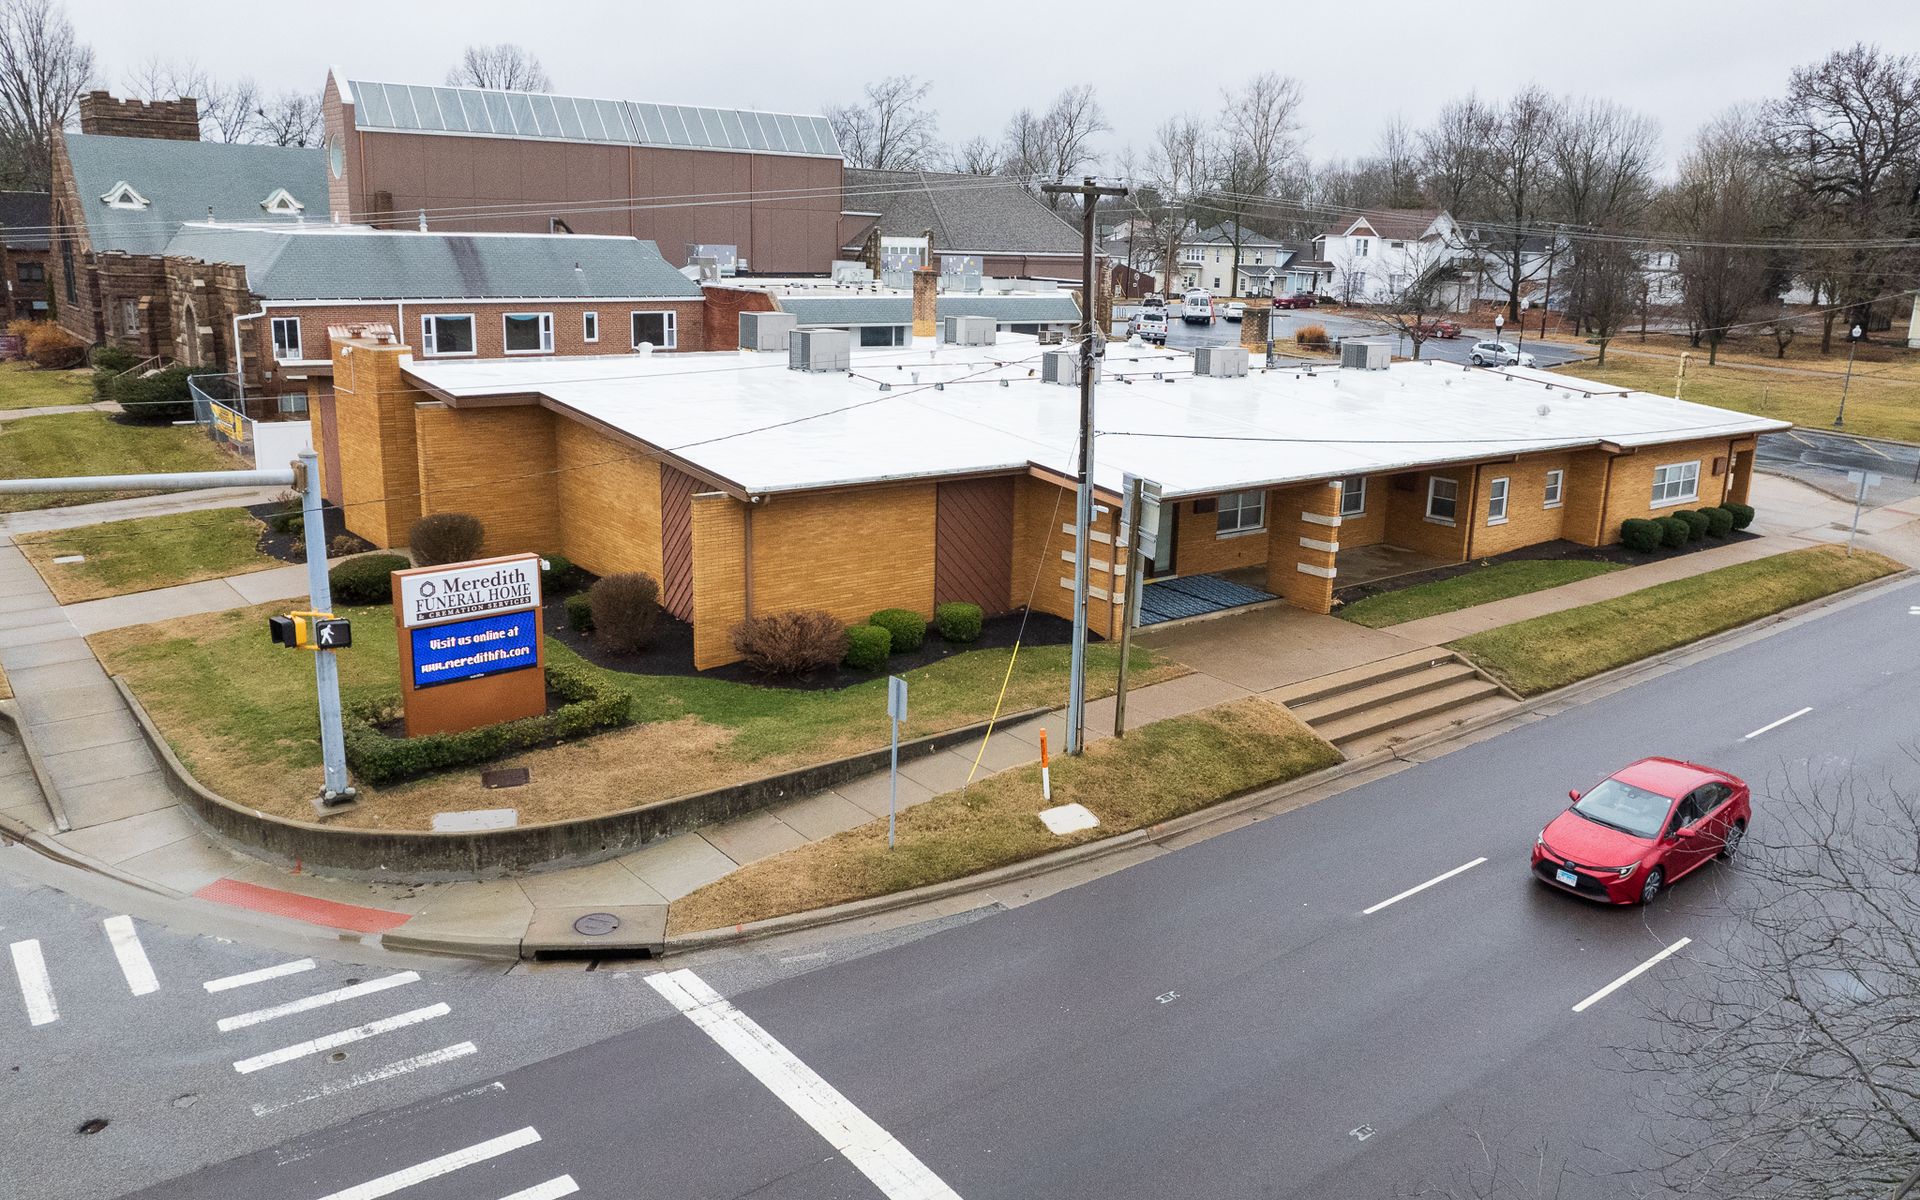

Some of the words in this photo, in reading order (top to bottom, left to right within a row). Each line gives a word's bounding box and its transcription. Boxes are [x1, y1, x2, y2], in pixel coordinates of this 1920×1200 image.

[442, 568, 525, 594] Meredith
[416, 590, 485, 612] FUNERAL
[488, 582, 531, 601] HOME
[428, 604, 485, 618] CREMATION
[487, 596, 530, 609] SERVICES
[429, 636, 456, 650] Visit
[457, 635, 472, 646] us
[473, 630, 506, 643] online
[507, 625, 519, 637] at
[421, 646, 530, 674] www.meredithfh.com
